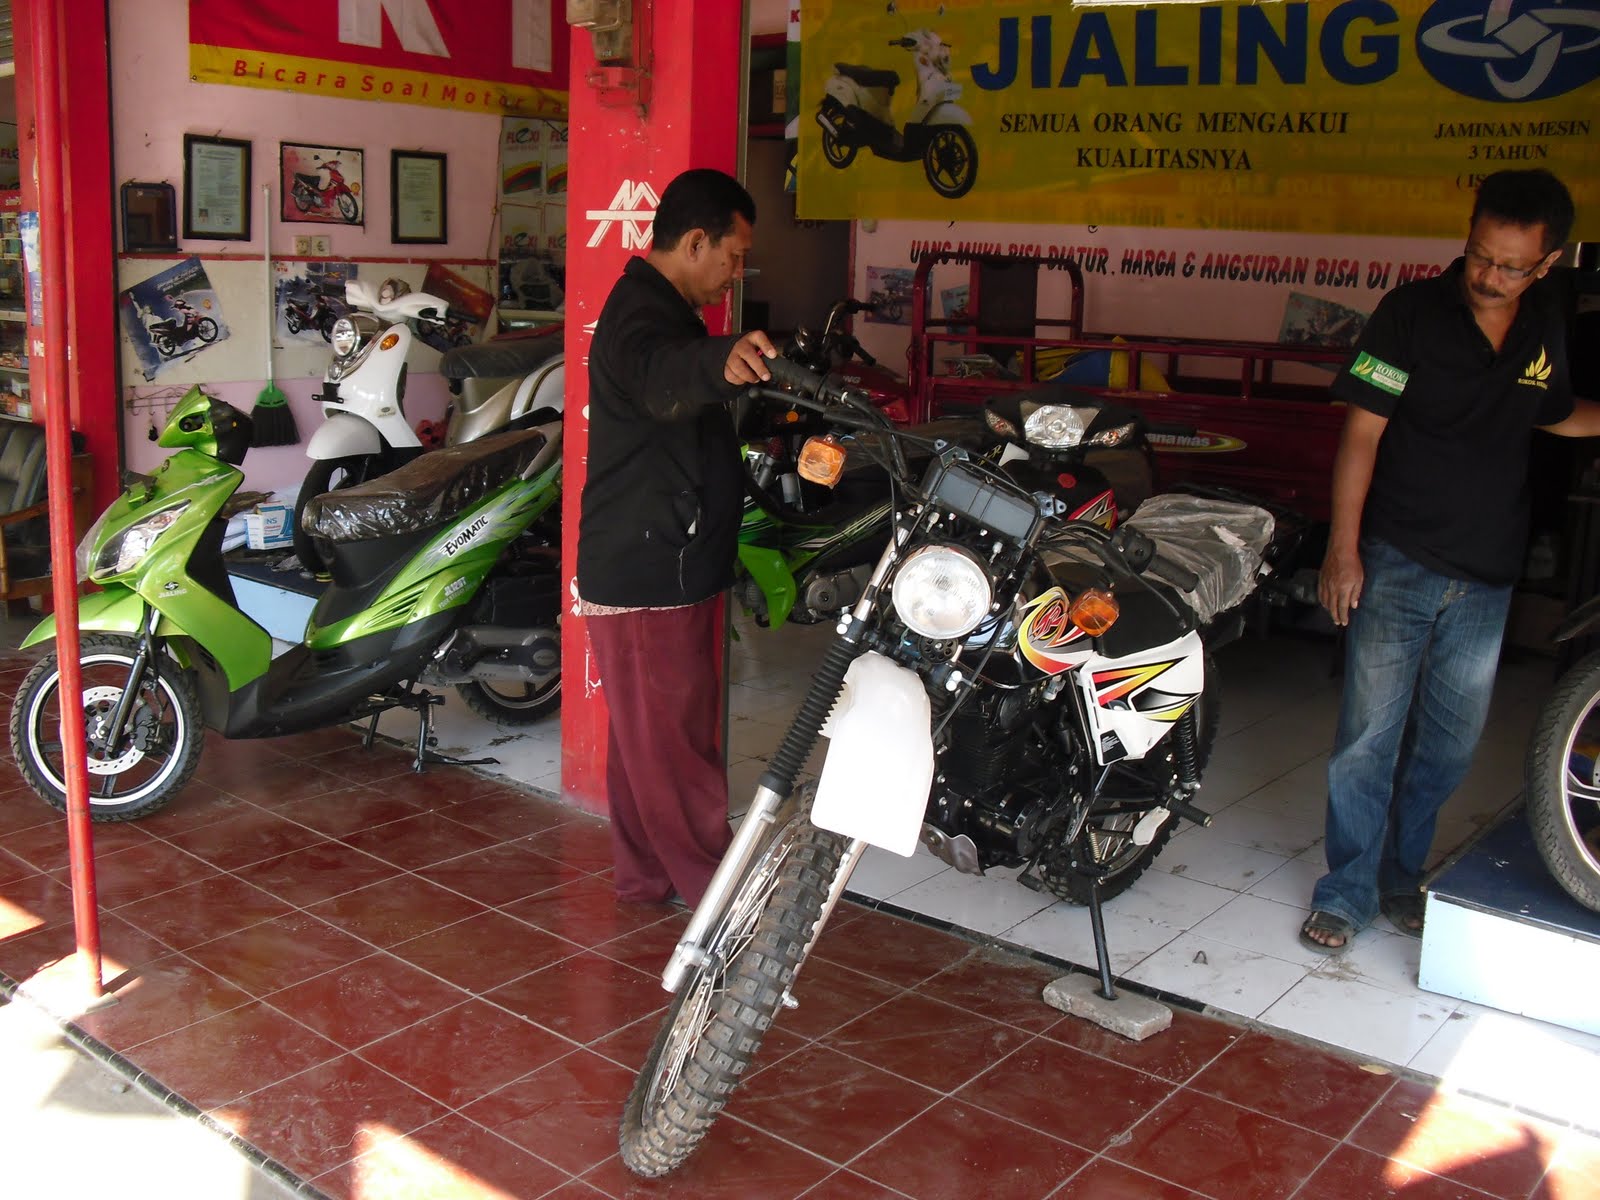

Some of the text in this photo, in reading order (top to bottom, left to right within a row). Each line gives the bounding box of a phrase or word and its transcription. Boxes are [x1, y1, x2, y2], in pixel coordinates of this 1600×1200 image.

[970, 0, 1400, 91] JIALING
[233, 60, 347, 88] Bicara
[360, 75, 429, 98] Soal
[441, 84, 525, 111] Motor
[999, 111, 1350, 135] SEMUA ORANG MENGAKUI
[1434, 119, 1591, 140] JAMINAN MESIN
[1076, 147, 1253, 171] KUALITASNYA
[1468, 144, 1549, 160] 3 TAHUN
[1121, 248, 1176, 278] HARGA
[1182, 251, 1196, 278] &
[1200, 252, 1310, 285] ANGSURAN
[1313, 257, 1361, 289] BISA
[1366, 260, 1393, 290] DI
[1395, 263, 1442, 286] NEG
[1375, 363, 1404, 383] ROKOK
